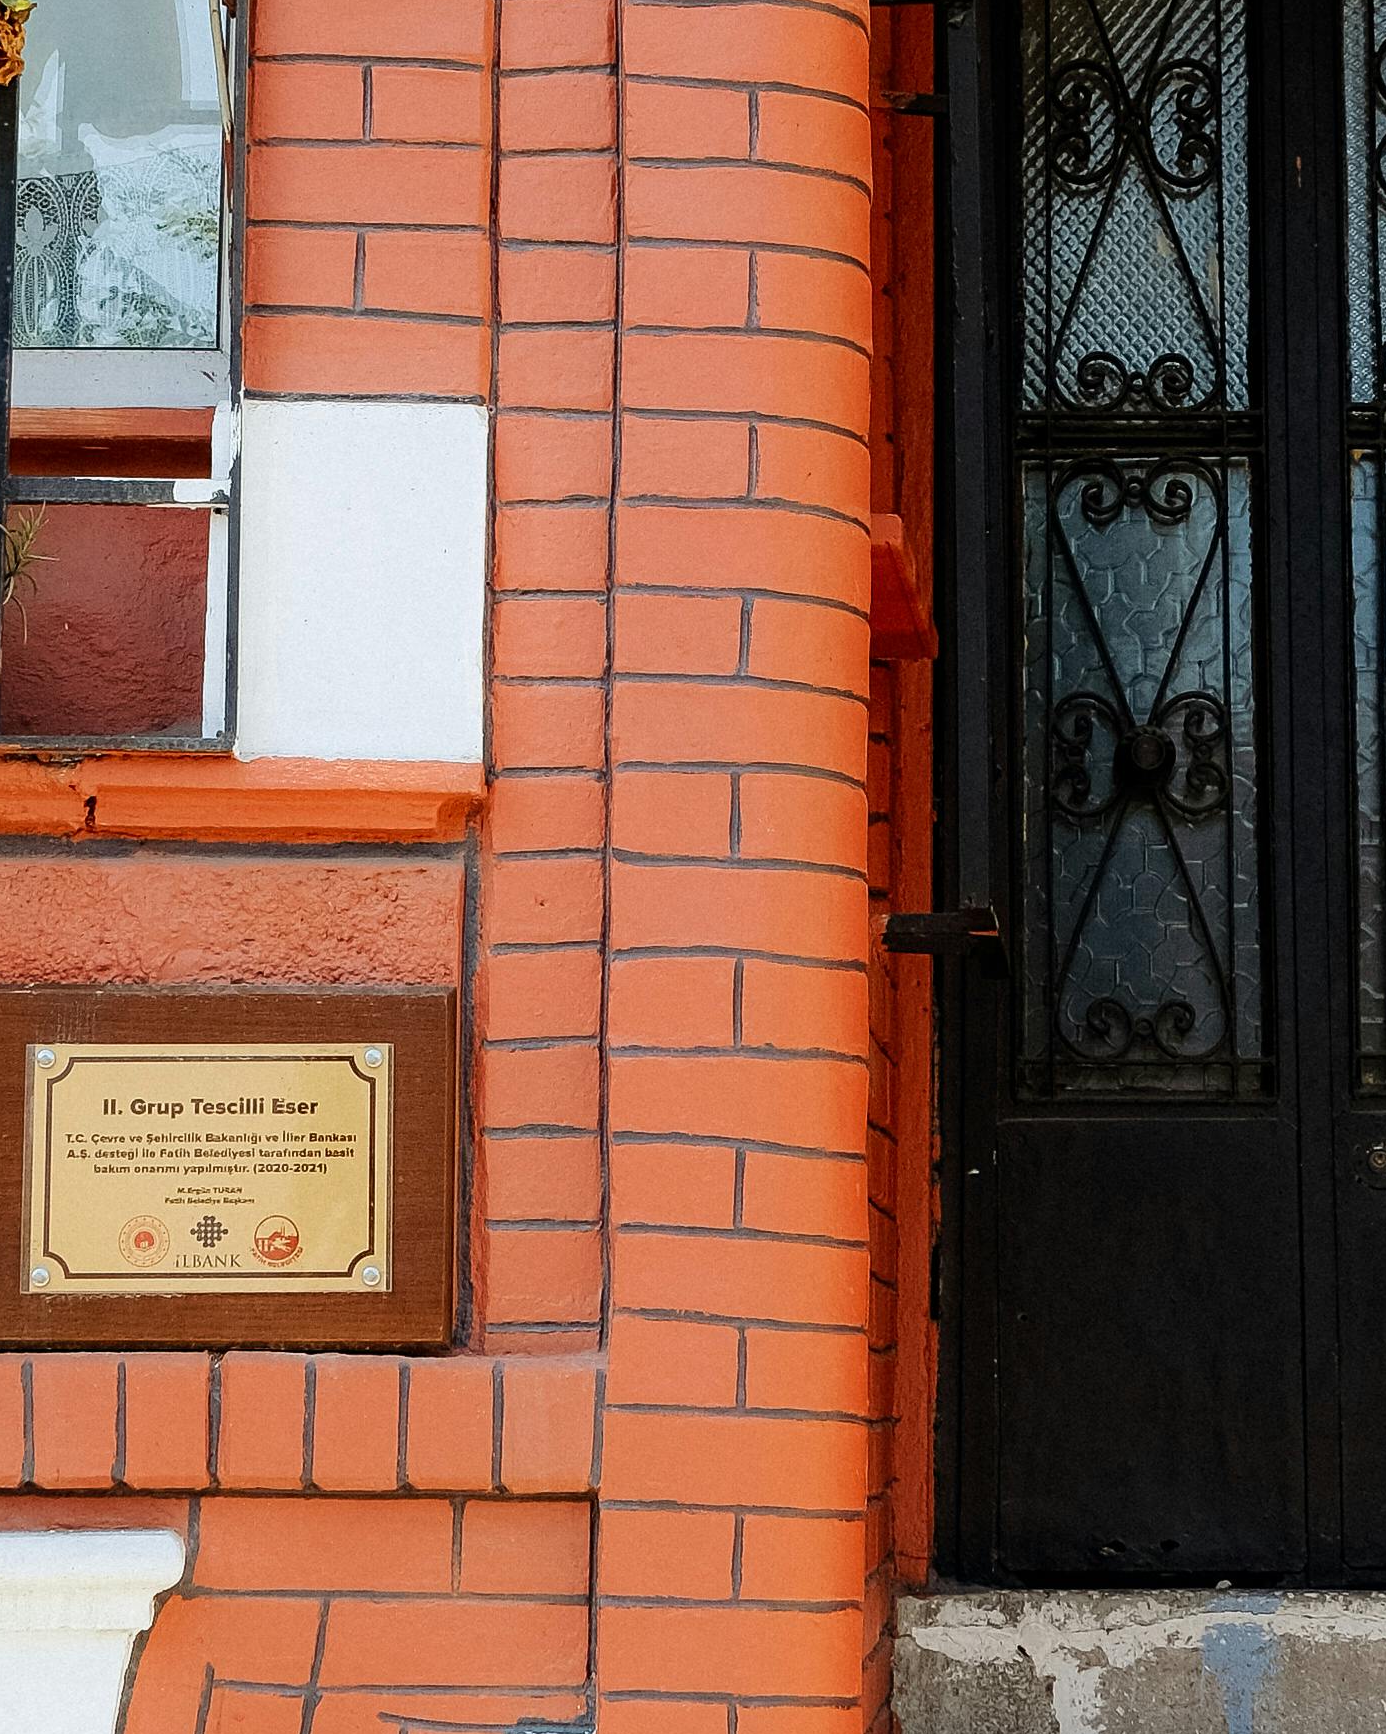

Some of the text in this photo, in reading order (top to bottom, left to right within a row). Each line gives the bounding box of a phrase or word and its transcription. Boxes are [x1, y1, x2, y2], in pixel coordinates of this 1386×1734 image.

[103, 1097, 318, 1118] II. Grup Tescilli Eser
[65, 1133, 88, 1143] T.C.
[91, 1133, 125, 1145] Çevre
[129, 1135, 142, 1143] ve
[146, 1132, 202, 1145] Şehircilik
[205, 1132, 262, 1144] Bakanlığı
[265, 1134, 279, 1142] ve
[309, 1132, 356, 1142] Bankası
[160, 1148, 190, 1158] Fatih
[194, 1147, 255, 1159] Belediyesi
[259, 1148, 321, 1158] tarafından
[325, 1147, 354, 1157] basit
[93, 1164, 130, 1173] bakım
[183, 1163, 250, 1175] yapılmıştır.
[253, 1163, 327, 1174] (2020-2021)
